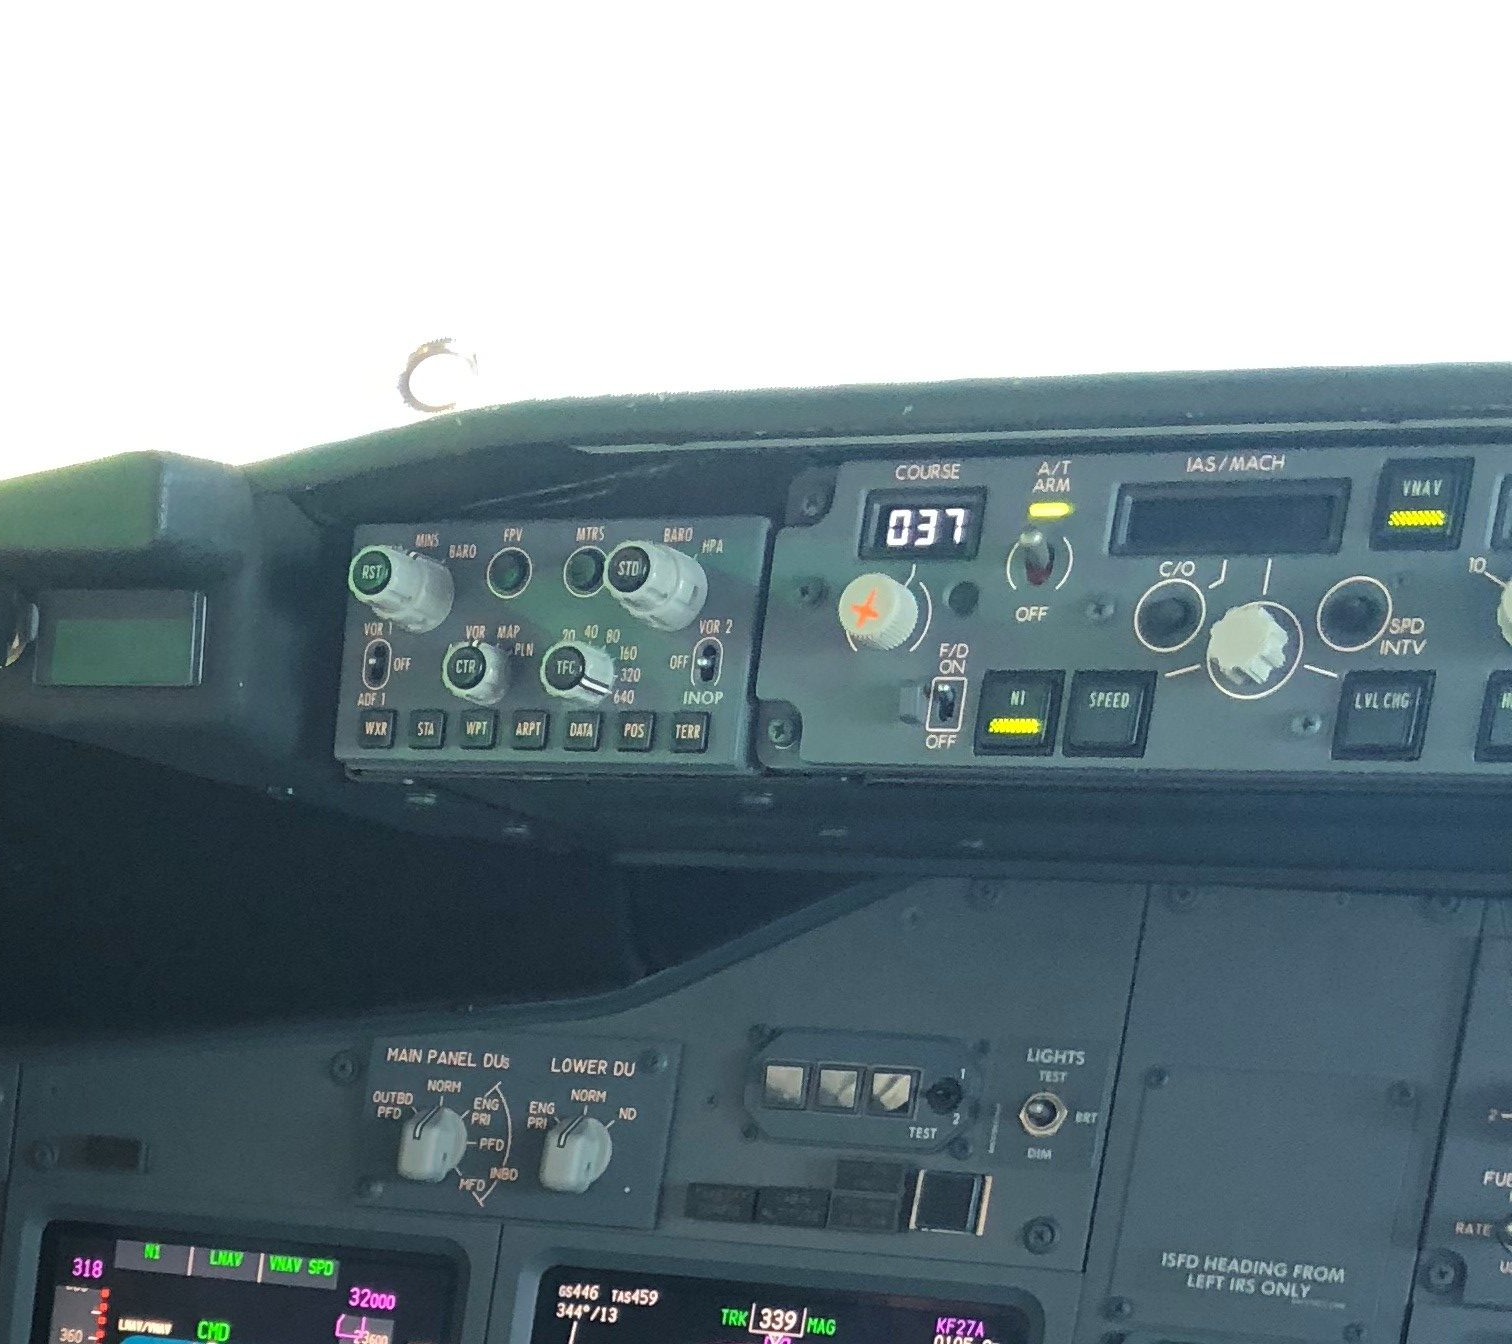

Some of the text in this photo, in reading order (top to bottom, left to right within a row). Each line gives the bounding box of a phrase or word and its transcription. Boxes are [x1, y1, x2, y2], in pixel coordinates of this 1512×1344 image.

[895, 462, 961, 480] COURSE
[1037, 460, 1071, 477] A/T
[1031, 476, 1071, 494] ARM
[1403, 480, 1442, 497] VNAV
[503, 527, 523, 542] FPV
[576, 526, 605, 541] MTRS
[663, 527, 693, 543] BARO
[886, 508, 966, 547] 037
[449, 544, 477, 559] BARO
[702, 539, 724, 555] HPA
[362, 563, 384, 579] RST
[618, 560, 639, 577] STD
[1159, 561, 1196, 578] C/O
[1015, 606, 1048, 622] OFF
[363, 622, 384, 636] VOR
[466, 625, 486, 639] VOR
[497, 624, 520, 639] MAP
[699, 619, 733, 634] VOR 2
[1388, 617, 1425, 635] SPD
[514, 641, 534, 657] PLN
[619, 645, 638, 661] 160
[939, 643, 969, 658] F/D
[1379, 638, 1426, 655] INTV
[393, 657, 411, 672] OFF
[455, 659, 476, 675] CTR
[556, 659, 576, 675] TFC
[670, 655, 688, 669] OFF
[939, 658, 966, 673] ON
[621, 668, 641, 683] 320
[357, 693, 379, 707] ADF
[613, 690, 634, 705] 640
[683, 690, 724, 706] INOP
[1089, 690, 1130, 708] SPEED
[1354, 691, 1410, 709] LVL CHG
[364, 722, 387, 737] WXR
[416, 723, 435, 737] STA
[465, 720, 488, 736] WPT
[515, 722, 541, 737] ARPT
[569, 722, 593, 738] DATA
[624, 722, 645, 738] POS
[675, 723, 701, 739] TERR
[926, 733, 956, 750] OFF
[387, 1047, 510, 1070] MAIN PANEL DUs
[1026, 1048, 1086, 1066] LIGHTS
[551, 1058, 635, 1077] LOWER DU
[1039, 1071, 1068, 1083] TEST
[427, 1079, 461, 1093] NORM
[372, 1091, 413, 1105] OUTBD
[473, 1097, 499, 1111] ENG
[570, 1089, 607, 1103] NORM
[377, 1106, 401, 1120] PFD
[529, 1101, 555, 1115] ENG
[619, 1107, 637, 1121] ND
[471, 1113, 491, 1126] PRI
[527, 1117, 547, 1130] PRI
[908, 1126, 937, 1140] TEST
[479, 1137, 504, 1151] PFD
[1027, 1148, 1052, 1160] DIM
[489, 1167, 518, 1181] INBD
[459, 1177, 485, 1192] MFD
[1455, 1222, 1492, 1237] RATE
[209, 1250, 244, 1268] LNAV
[269, 1254, 334, 1277] VNAV SPD
[72, 1259, 103, 1279] 318
[1161, 1251, 1345, 1284] ISFD HEADING FROM
[1186, 1272, 1311, 1299] LEFT IRS ONLY
[349, 1288, 395, 1311] 32000
[558, 1284, 658, 1306] GS446 TAS459
[721, 1308, 749, 1327] TRK
[759, 1308, 797, 1331] 339
[197, 1320, 230, 1342] CMD
[807, 1317, 836, 1336] MAG
[936, 1317, 985, 1338] KF27A
